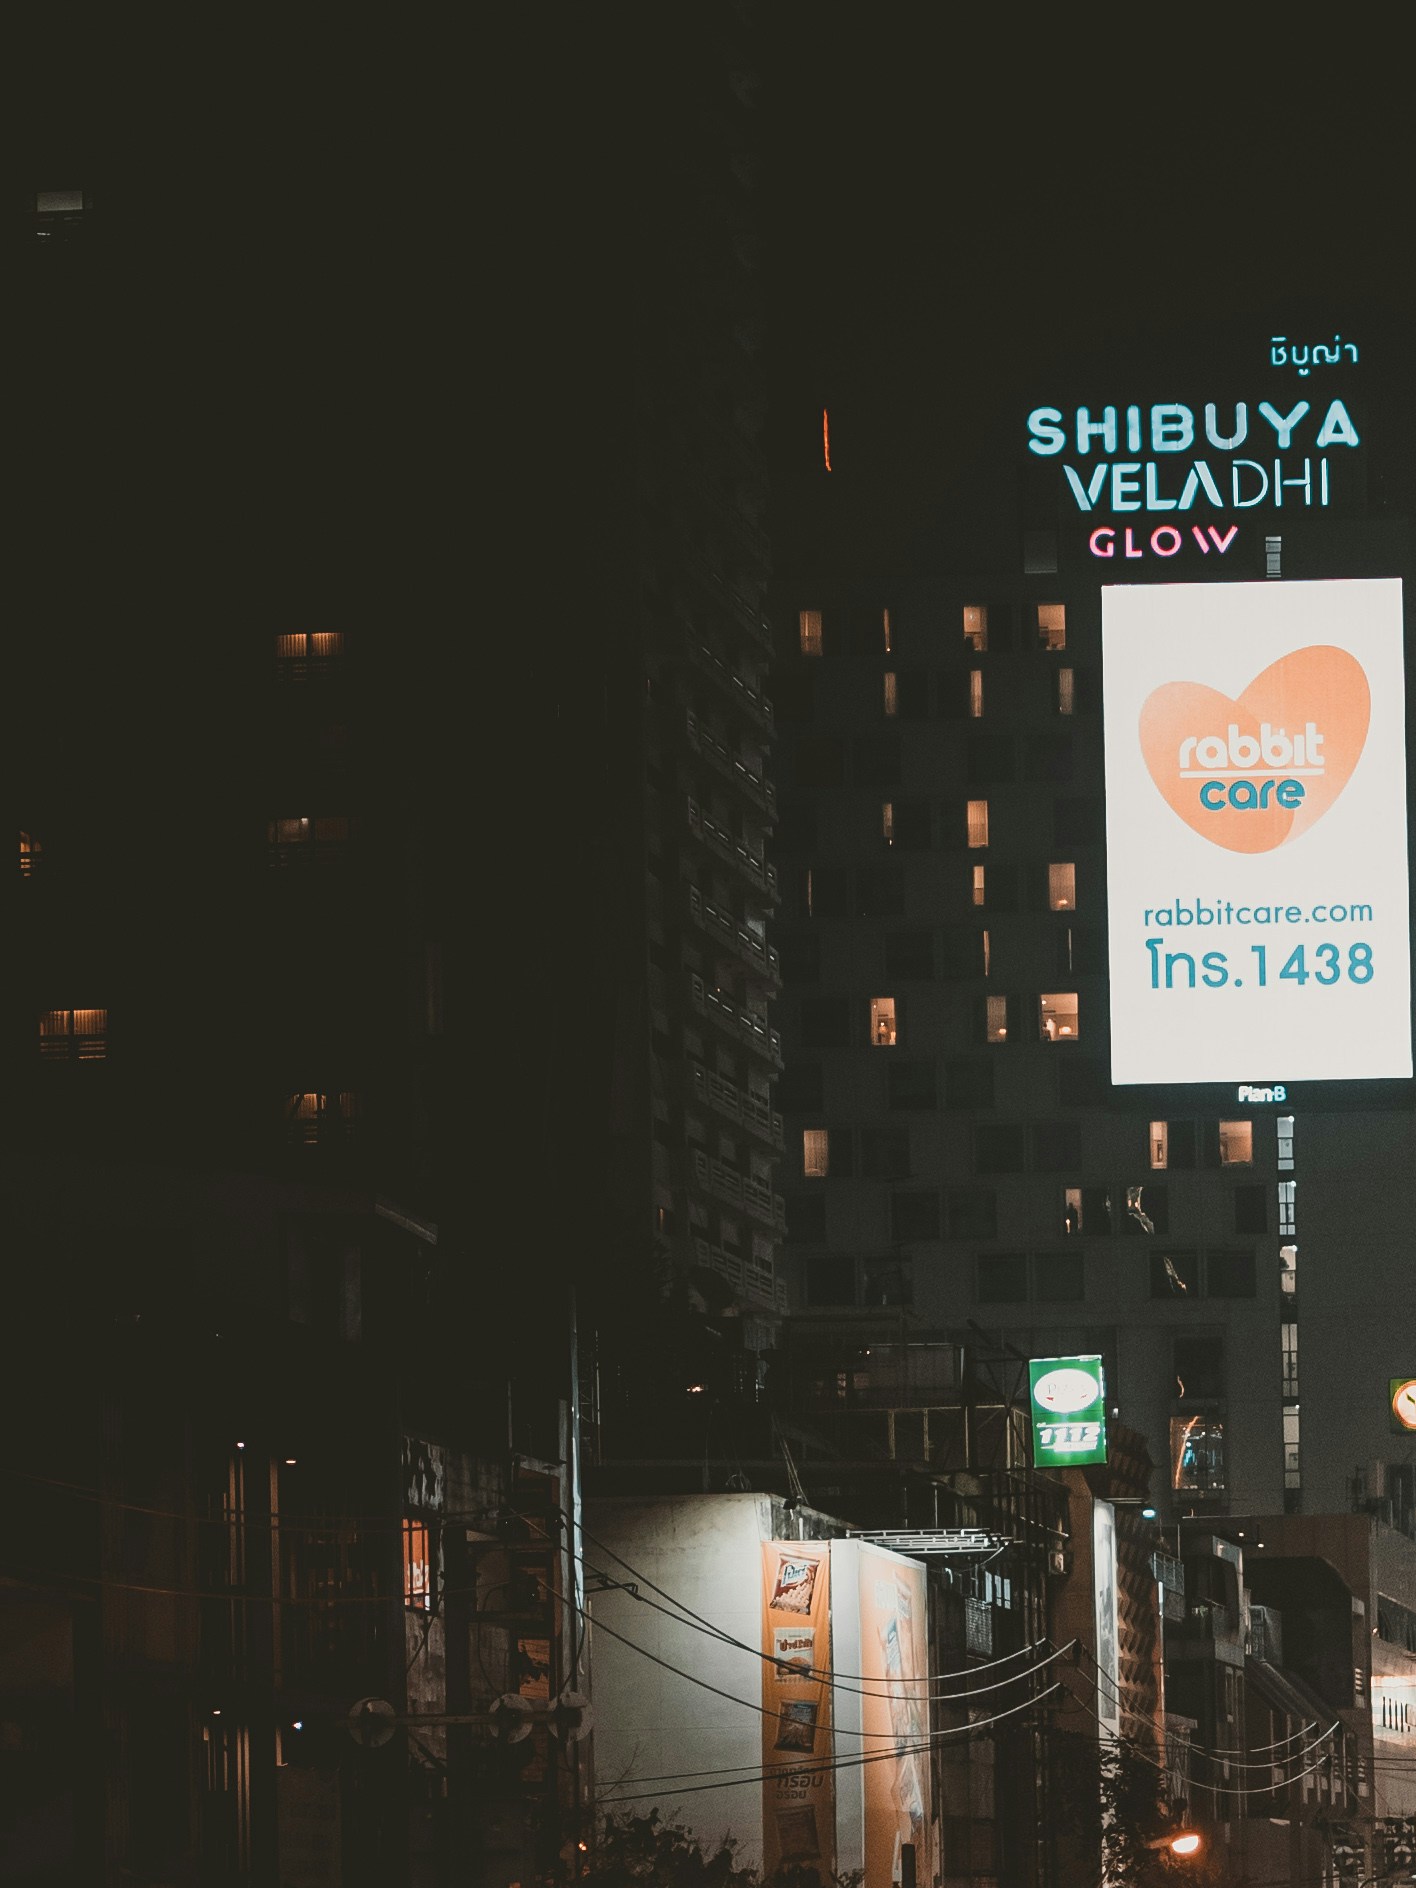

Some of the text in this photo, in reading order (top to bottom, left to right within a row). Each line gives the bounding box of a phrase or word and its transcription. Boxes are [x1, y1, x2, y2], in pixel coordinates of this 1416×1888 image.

[1027, 399, 1360, 455] SHIBUYA
[1063, 457, 1329, 511] VELADHI
[1089, 525, 1239, 558] GLOW
[1179, 721, 1325, 769] rabbit
[1199, 778, 1306, 811] care
[1144, 897, 1373, 927] rabbitcare.com
